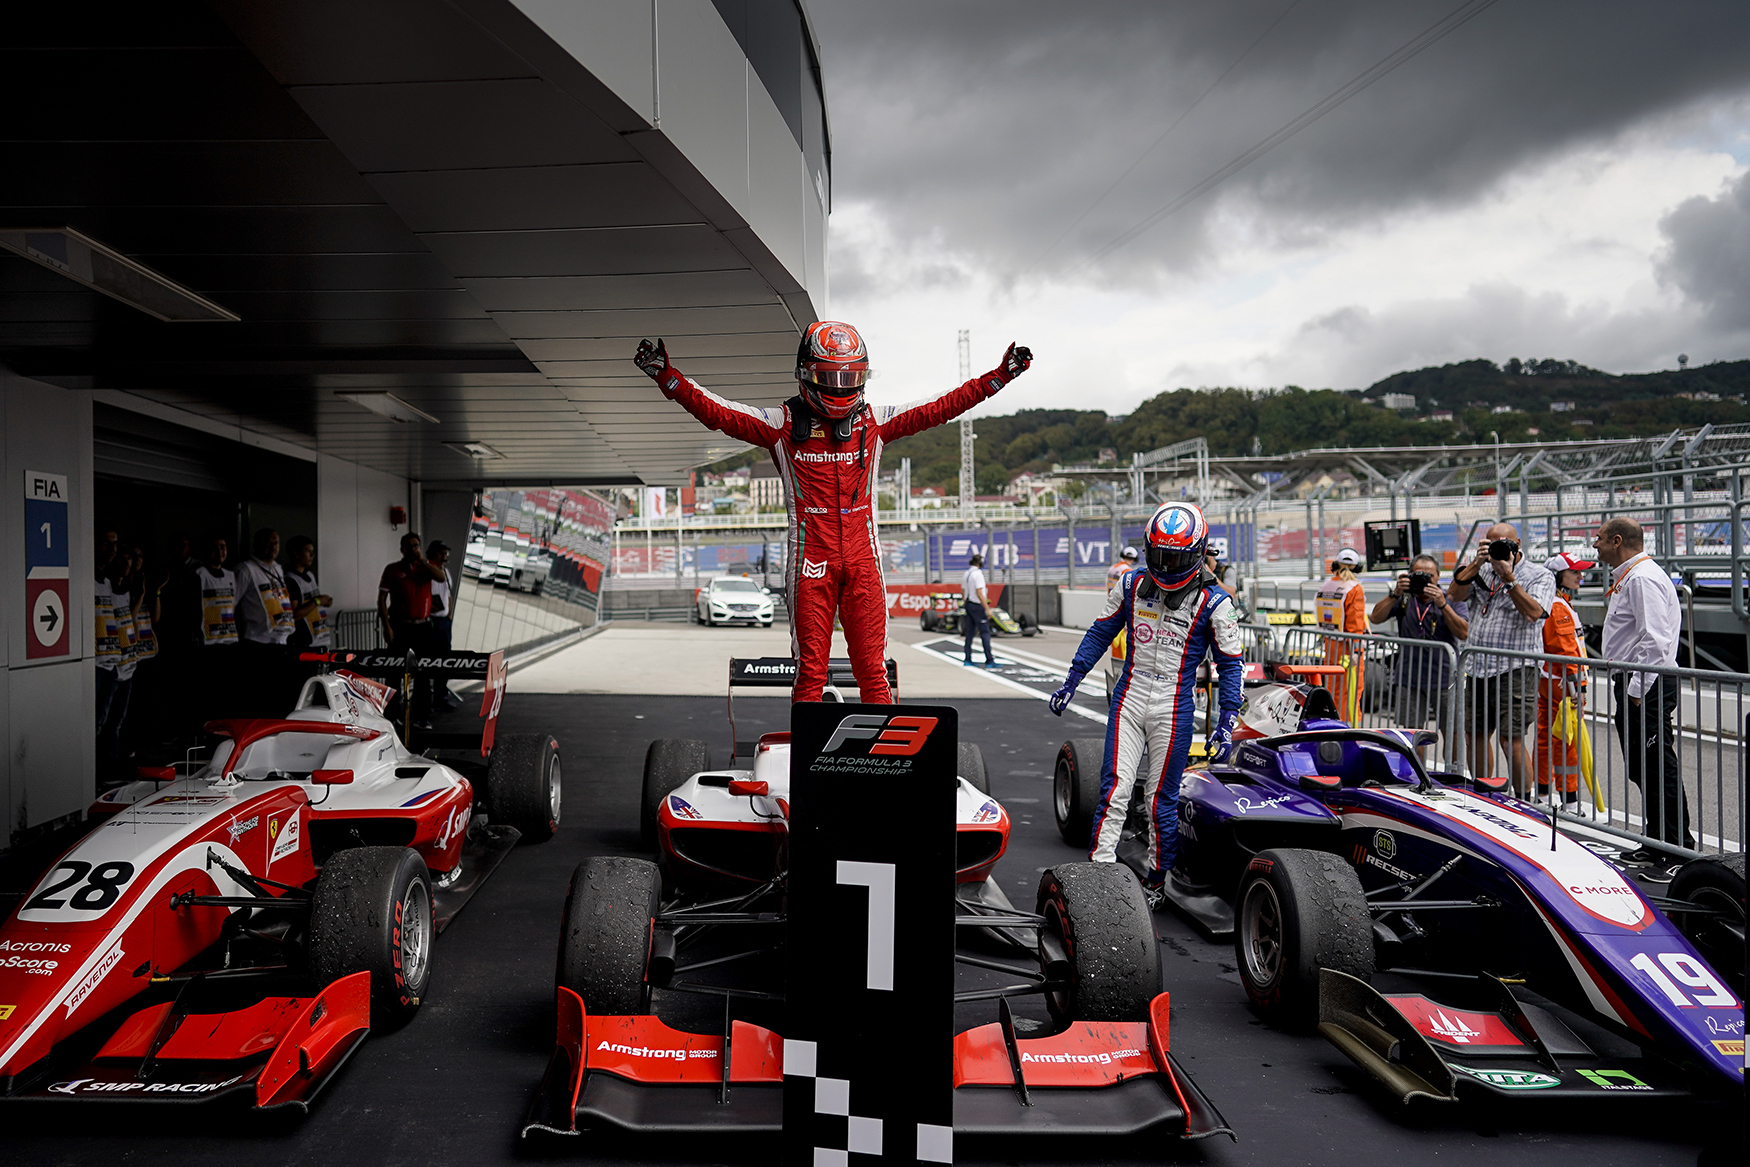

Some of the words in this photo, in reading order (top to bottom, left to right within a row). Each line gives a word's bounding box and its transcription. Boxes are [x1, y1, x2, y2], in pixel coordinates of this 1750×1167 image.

[794, 450, 853, 465] Armstrong
[34, 478, 61, 499] FIA
[40, 522, 52, 549] 1
[1077, 541, 1124, 564] VT
[900, 592, 946, 607] Espos
[1156, 629, 1177, 638] HEAD
[1156, 636, 1184, 648] TEAM
[417, 656, 489, 668] RACING
[743, 663, 795, 674] Armstro
[822, 714, 939, 756] F3
[815, 756, 835, 764] FIA
[836, 757, 901, 768] FORMULA
[1378, 836, 1392, 851] STS
[1248, 858, 1275, 874] PIRELLI
[19, 861, 135, 912] 28
[1569, 885, 1583, 894] C
[1585, 886, 1633, 896] MORE
[836, 860, 896, 991] 1
[0, 939, 72, 953] Acronis
[392, 900, 405, 989] ZERO
[25, 968, 53, 976] .com
[1629, 952, 1741, 1009] 19
[1431, 1028, 1480, 1037] TRIDENT
[597, 1040, 687, 1061] Armstrong
[1021, 1052, 1112, 1064] Armstrong
[82, 1082, 145, 1092] SMP
